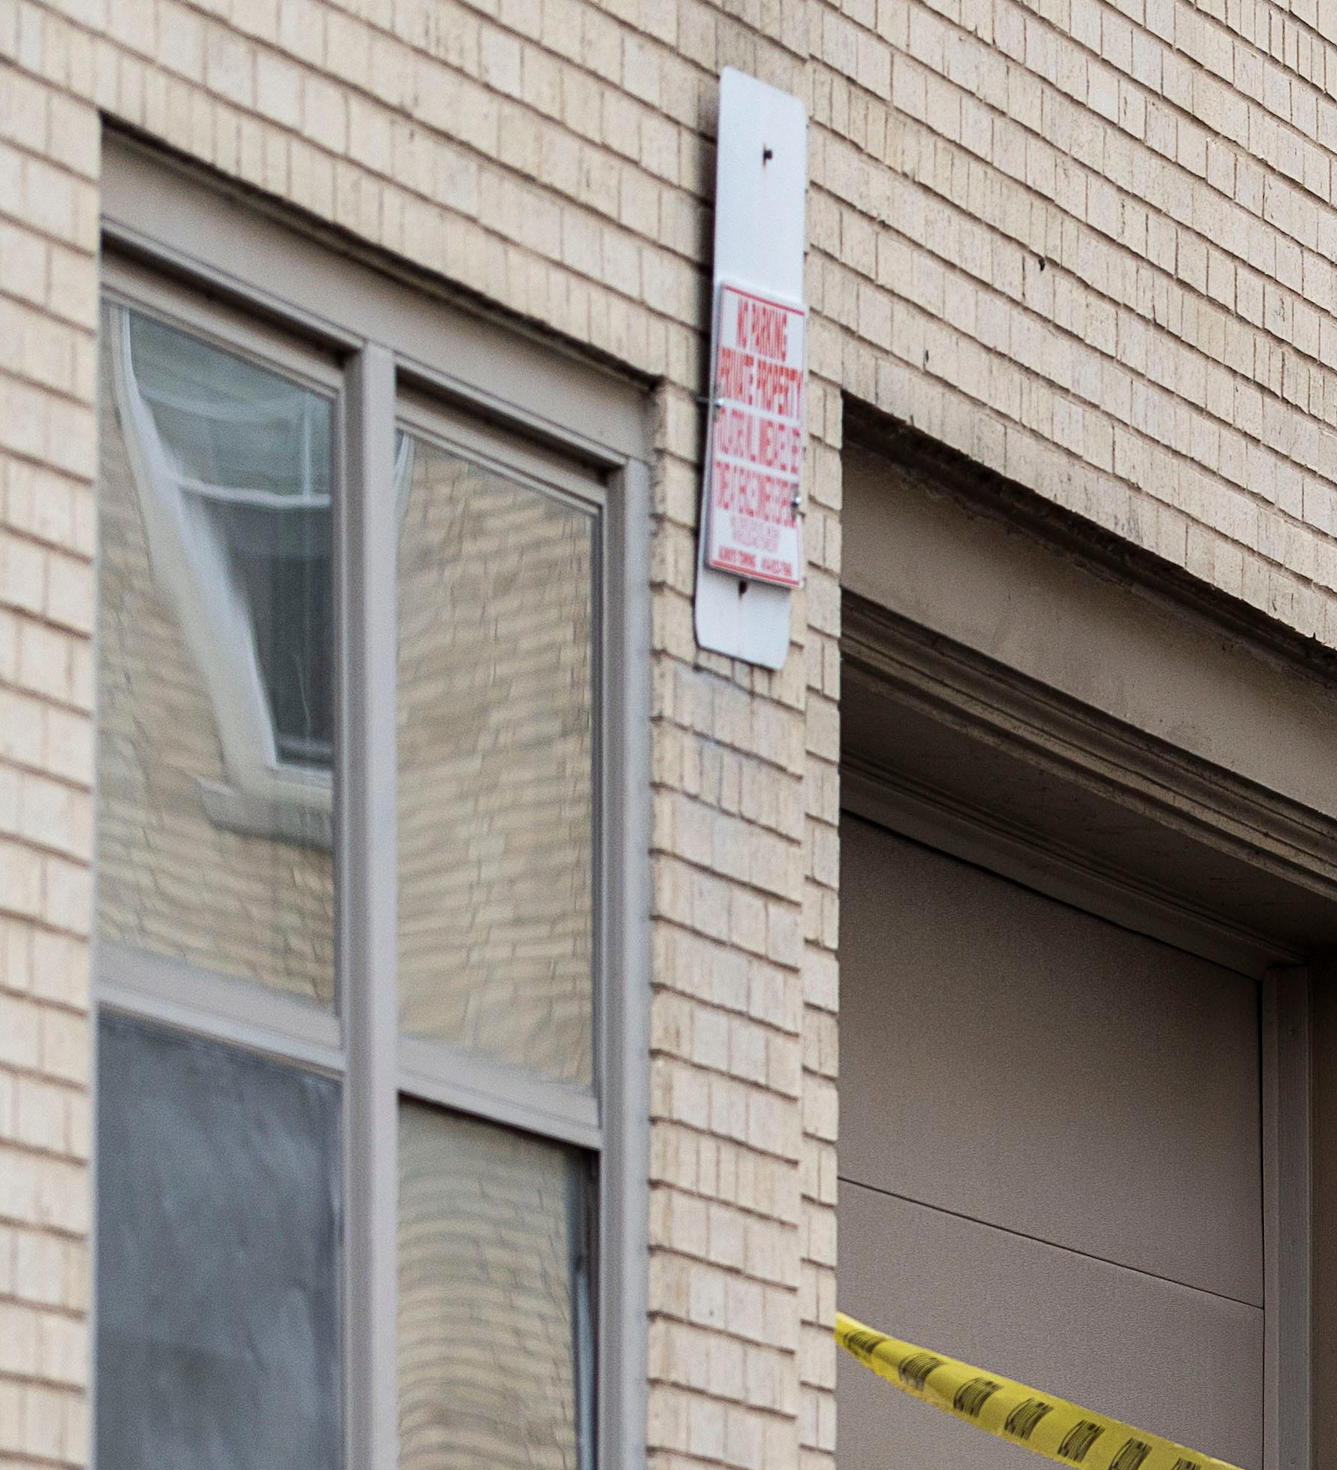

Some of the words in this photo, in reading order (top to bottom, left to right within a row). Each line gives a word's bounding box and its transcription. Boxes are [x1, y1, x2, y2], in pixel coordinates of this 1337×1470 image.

[737, 298, 749, 350] NO
[752, 302, 787, 362] PARKING
[719, 345, 754, 406] PRIVATE
[757, 358, 803, 420] PROPERTY
